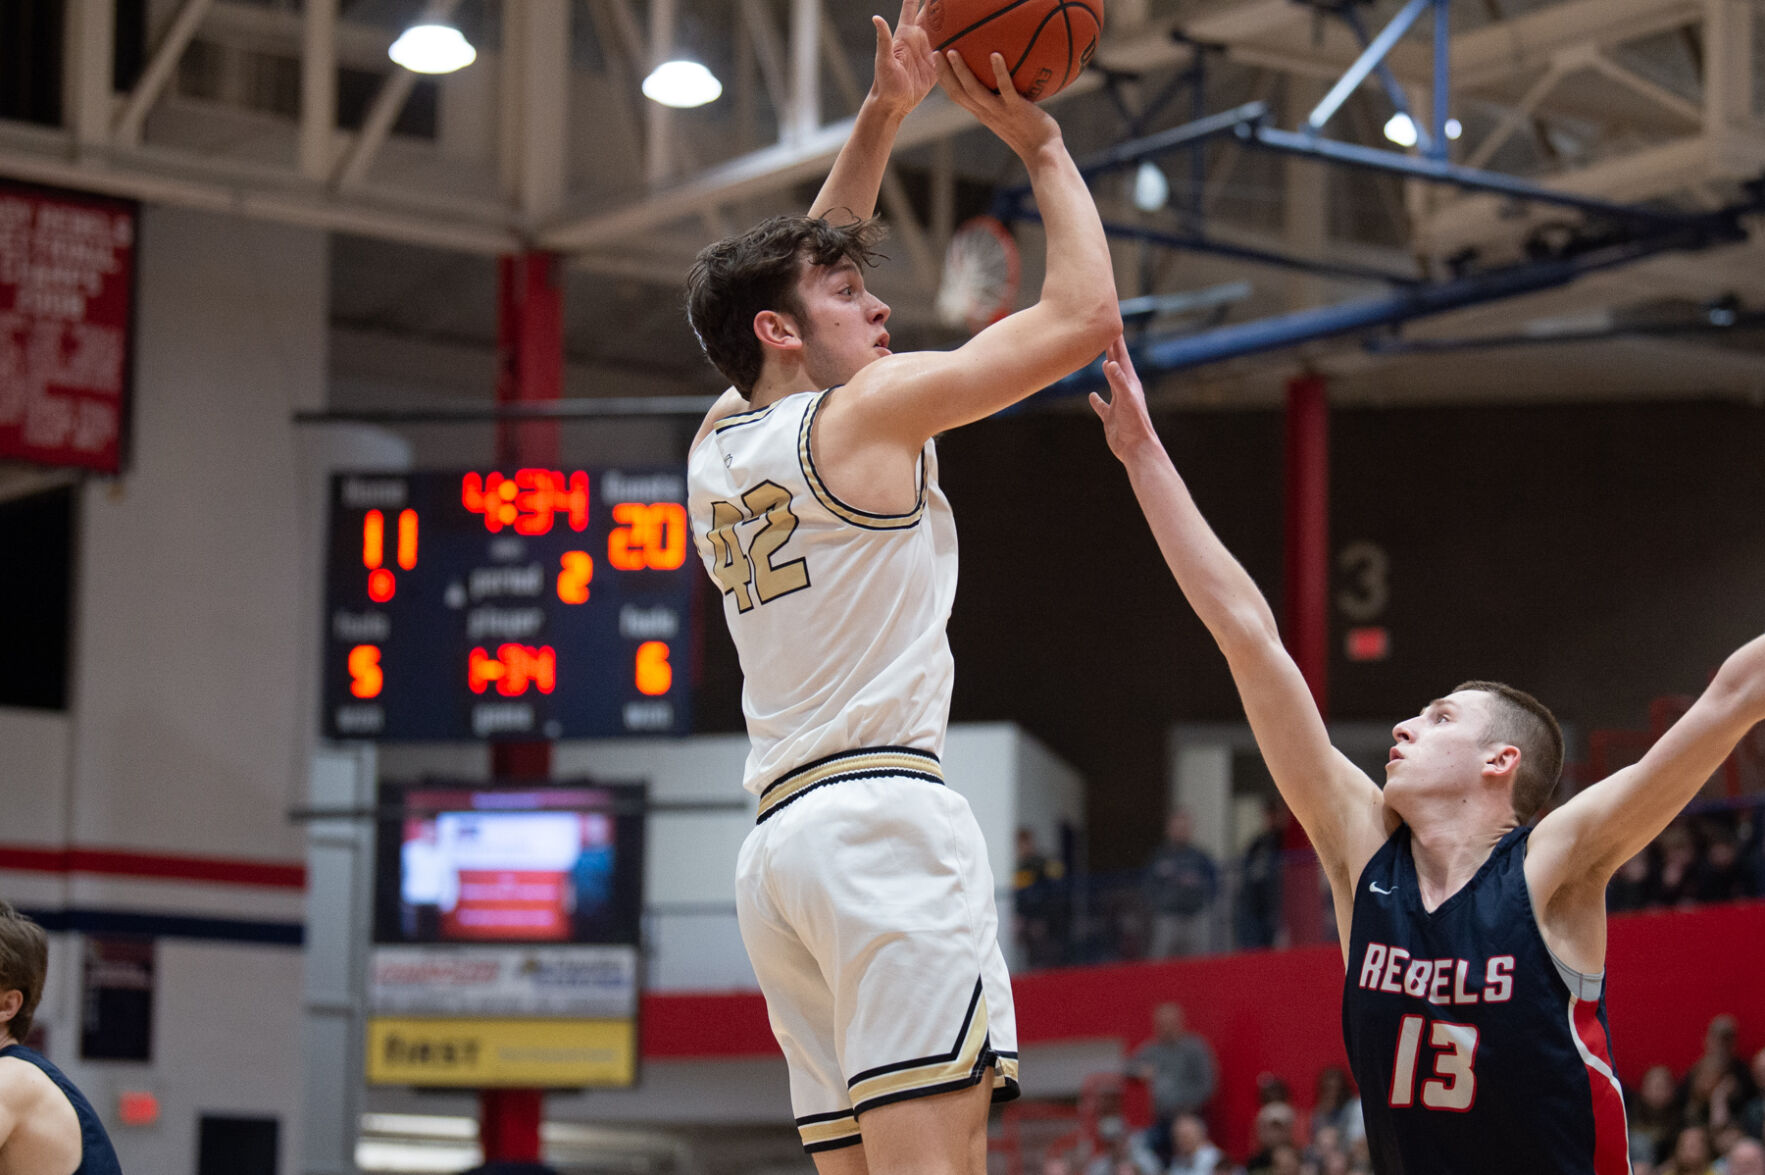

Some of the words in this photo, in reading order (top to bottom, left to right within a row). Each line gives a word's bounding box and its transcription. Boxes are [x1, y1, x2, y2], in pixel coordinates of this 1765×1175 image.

[462, 468, 590, 536] 4:34
[363, 508, 419, 570] 11
[608, 502, 687, 571] 20
[706, 479, 811, 614] 42
[556, 550, 594, 605] 2
[1338, 540, 1388, 618] 3
[347, 644, 384, 699] 5
[635, 641, 673, 696] 6
[1358, 941, 1516, 1005] REBELS
[1388, 1013, 1481, 1114] 13
